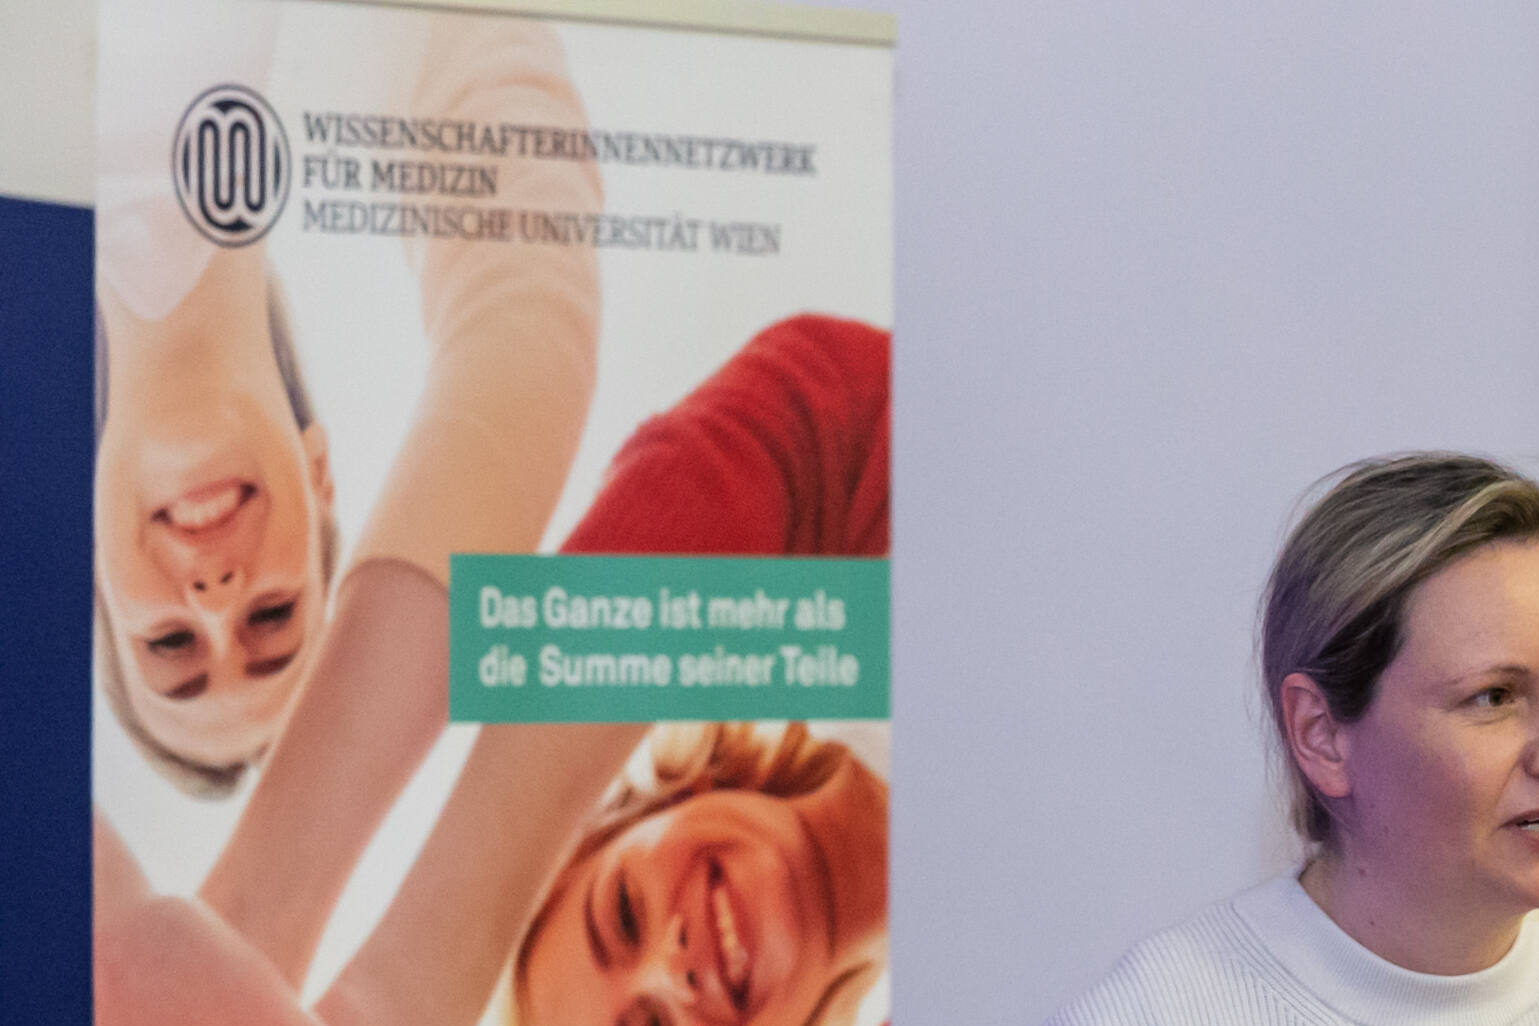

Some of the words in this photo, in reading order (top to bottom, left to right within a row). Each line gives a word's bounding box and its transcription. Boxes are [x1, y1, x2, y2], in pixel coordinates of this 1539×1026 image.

[303, 150, 361, 190] FÜR
[370, 158, 498, 198] MEDIZIN
[303, 198, 511, 242] MEDIZINISCHE
[519, 209, 704, 252] UNIVERSITÄT
[709, 219, 782, 256] WIEN
[480, 586, 538, 628] Das
[543, 586, 653, 629] Ganze
[659, 588, 701, 629] ist
[708, 589, 791, 630] mehr
[795, 589, 846, 630] als
[479, 645, 527, 686] die
[539, 643, 671, 687] Summe
[678, 646, 775, 687] seiner
[780, 645, 860, 687] Teile
